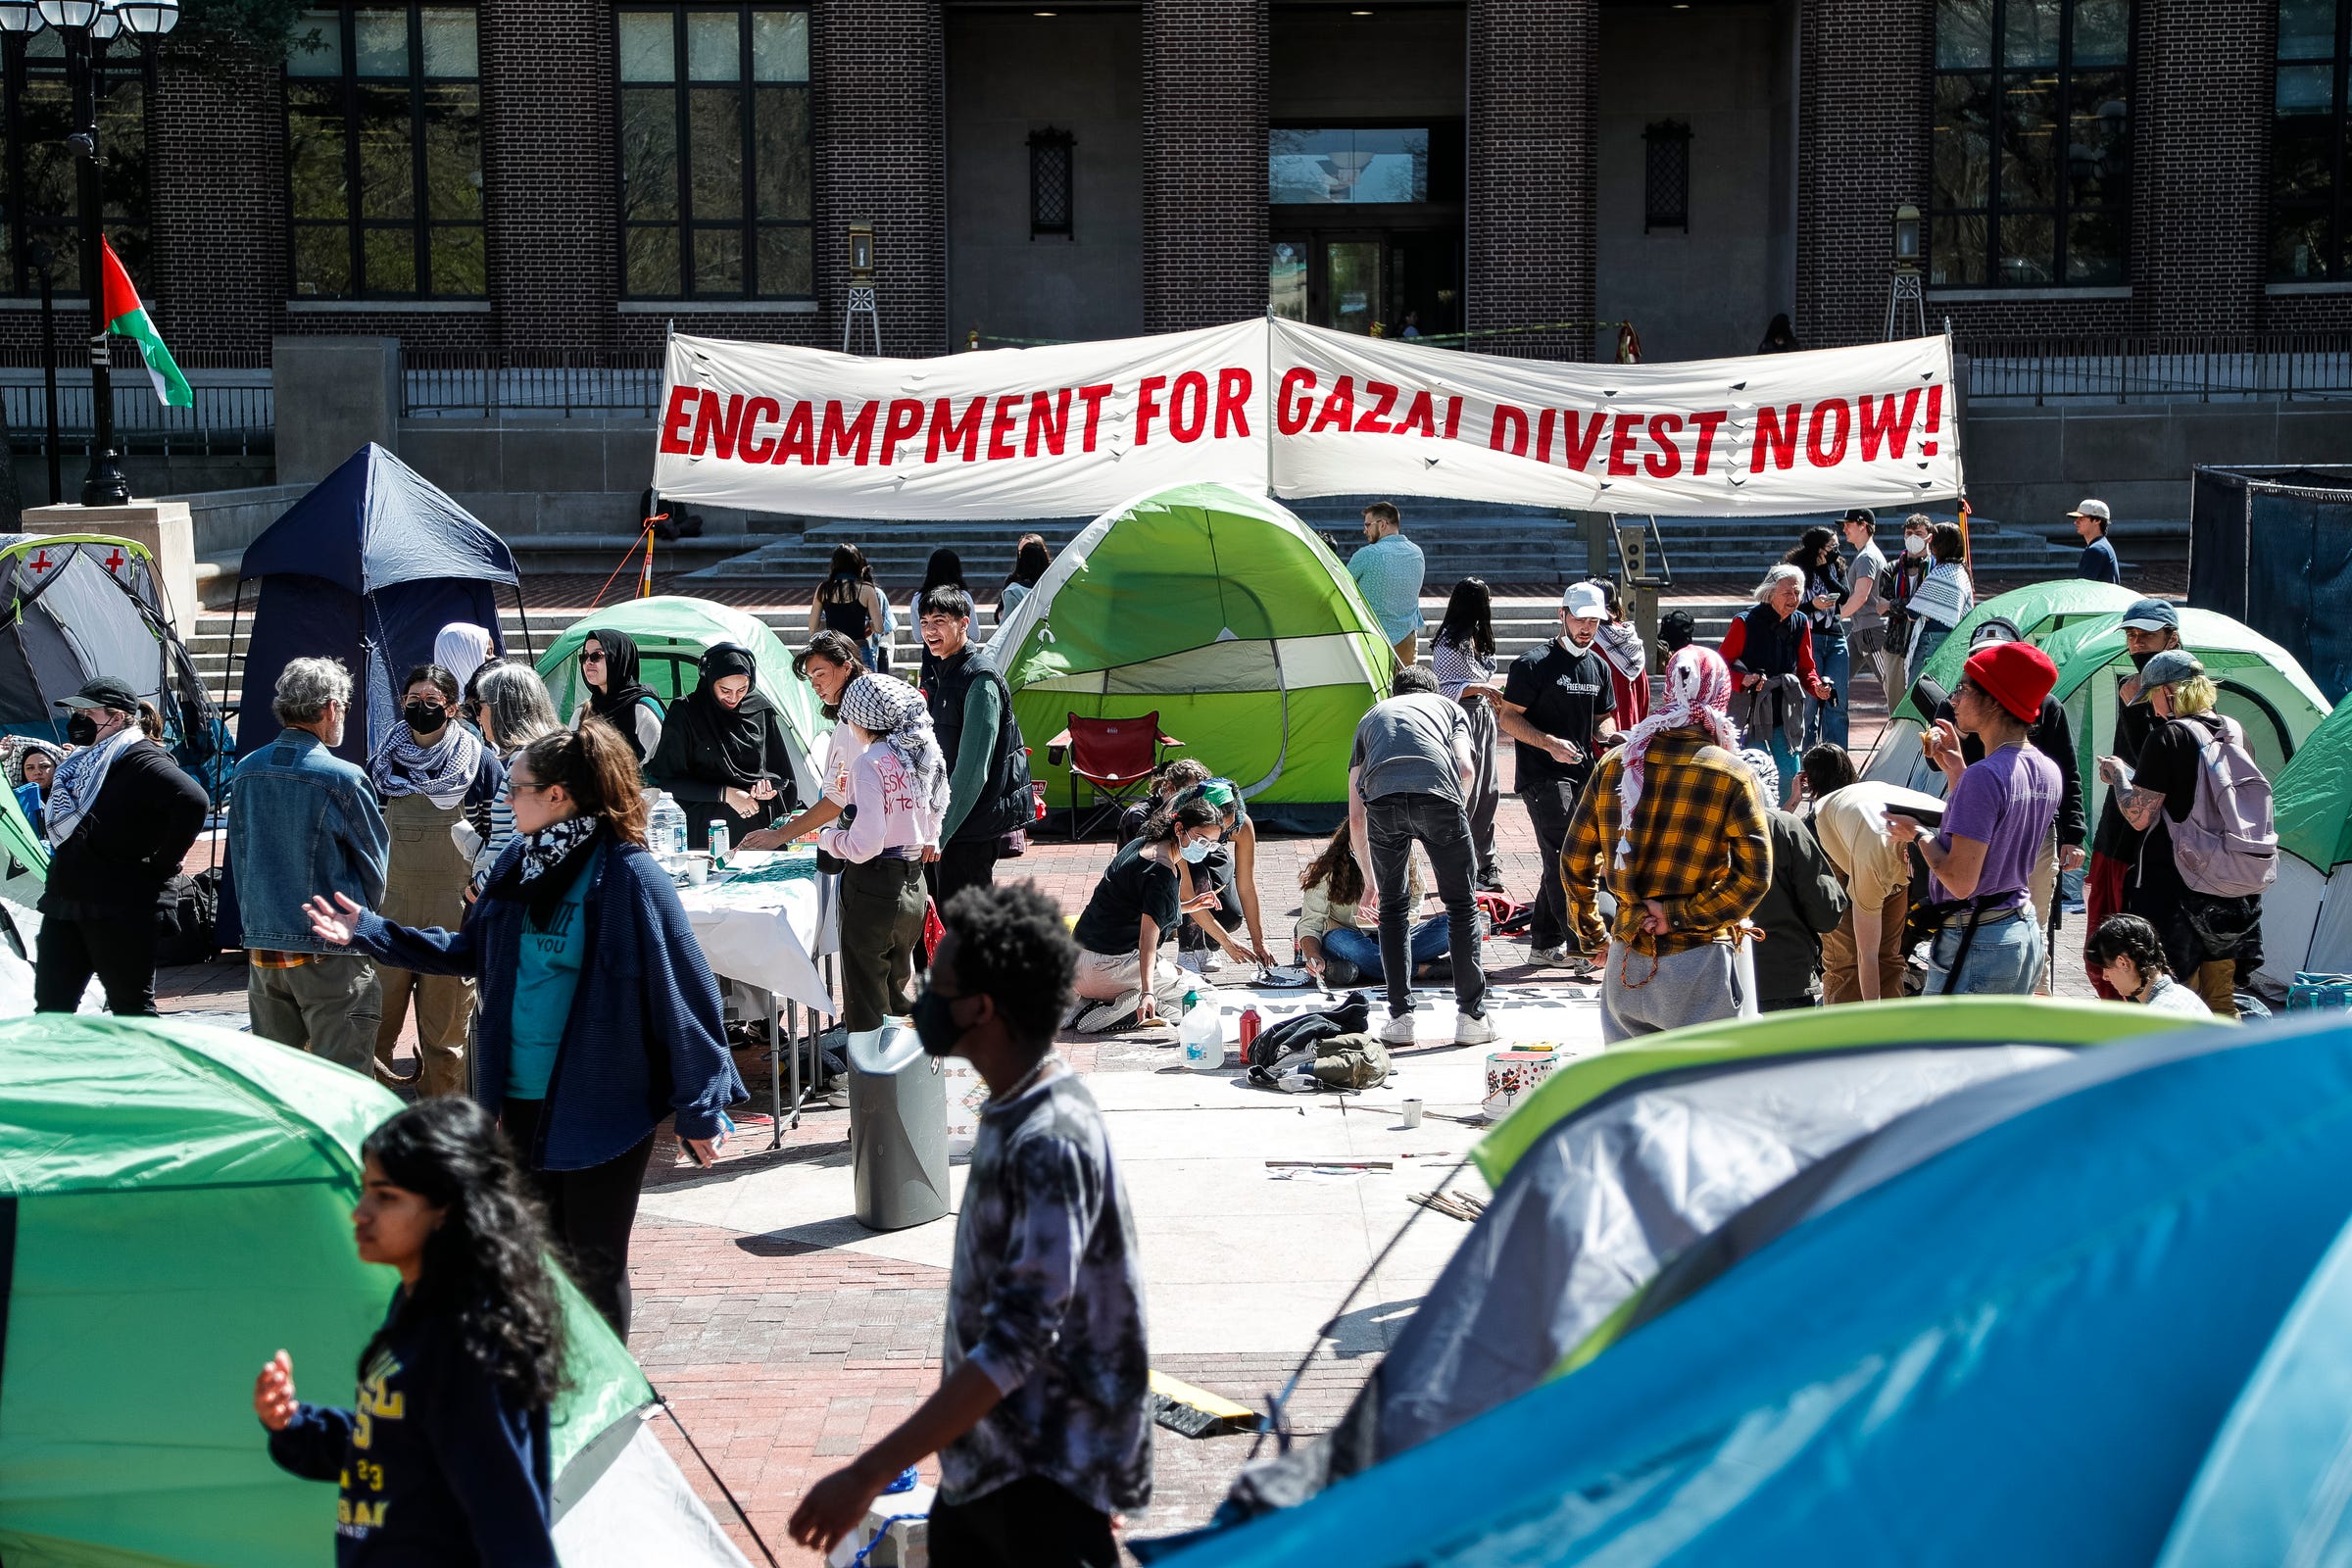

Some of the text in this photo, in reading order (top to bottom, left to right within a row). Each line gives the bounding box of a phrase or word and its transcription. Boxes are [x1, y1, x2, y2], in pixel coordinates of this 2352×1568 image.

[662, 383, 1113, 466] ENCAMPMENT
[1135, 368, 1252, 446] FOR
[1491, 405, 1725, 478] DIVEST
[1750, 385, 1942, 473] NOW!
[536, 937, 565, 954] YOU
